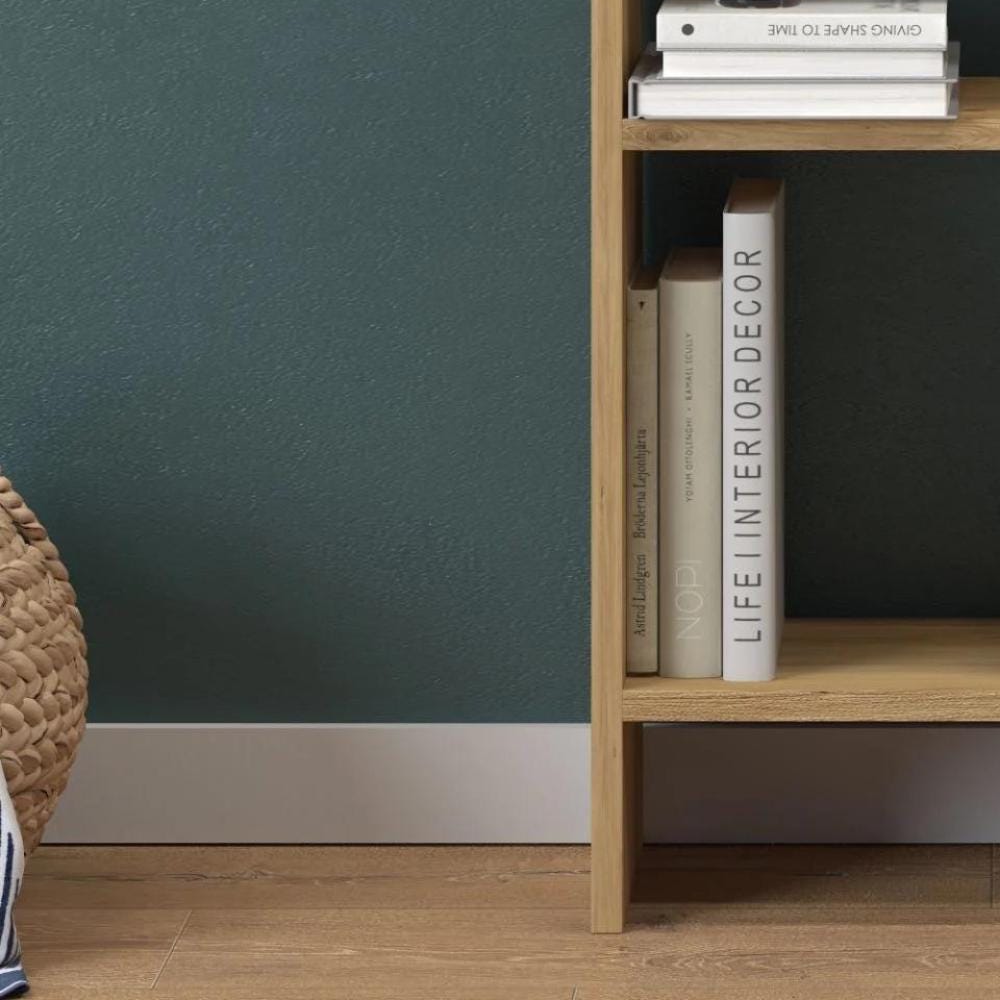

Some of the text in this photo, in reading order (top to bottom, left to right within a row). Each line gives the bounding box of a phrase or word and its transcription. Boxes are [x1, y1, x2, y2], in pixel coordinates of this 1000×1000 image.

[767, 24, 922, 37] GIVING SHAPE TO TIME
[734, 249, 762, 363] DECOR
[734, 377, 762, 538] INTERIOR
[632, 554, 649, 602] Lindgren
[674, 560, 704, 640] NOPI
[734, 572, 762, 643] LIFE
[632, 605, 646, 637] Astrid
